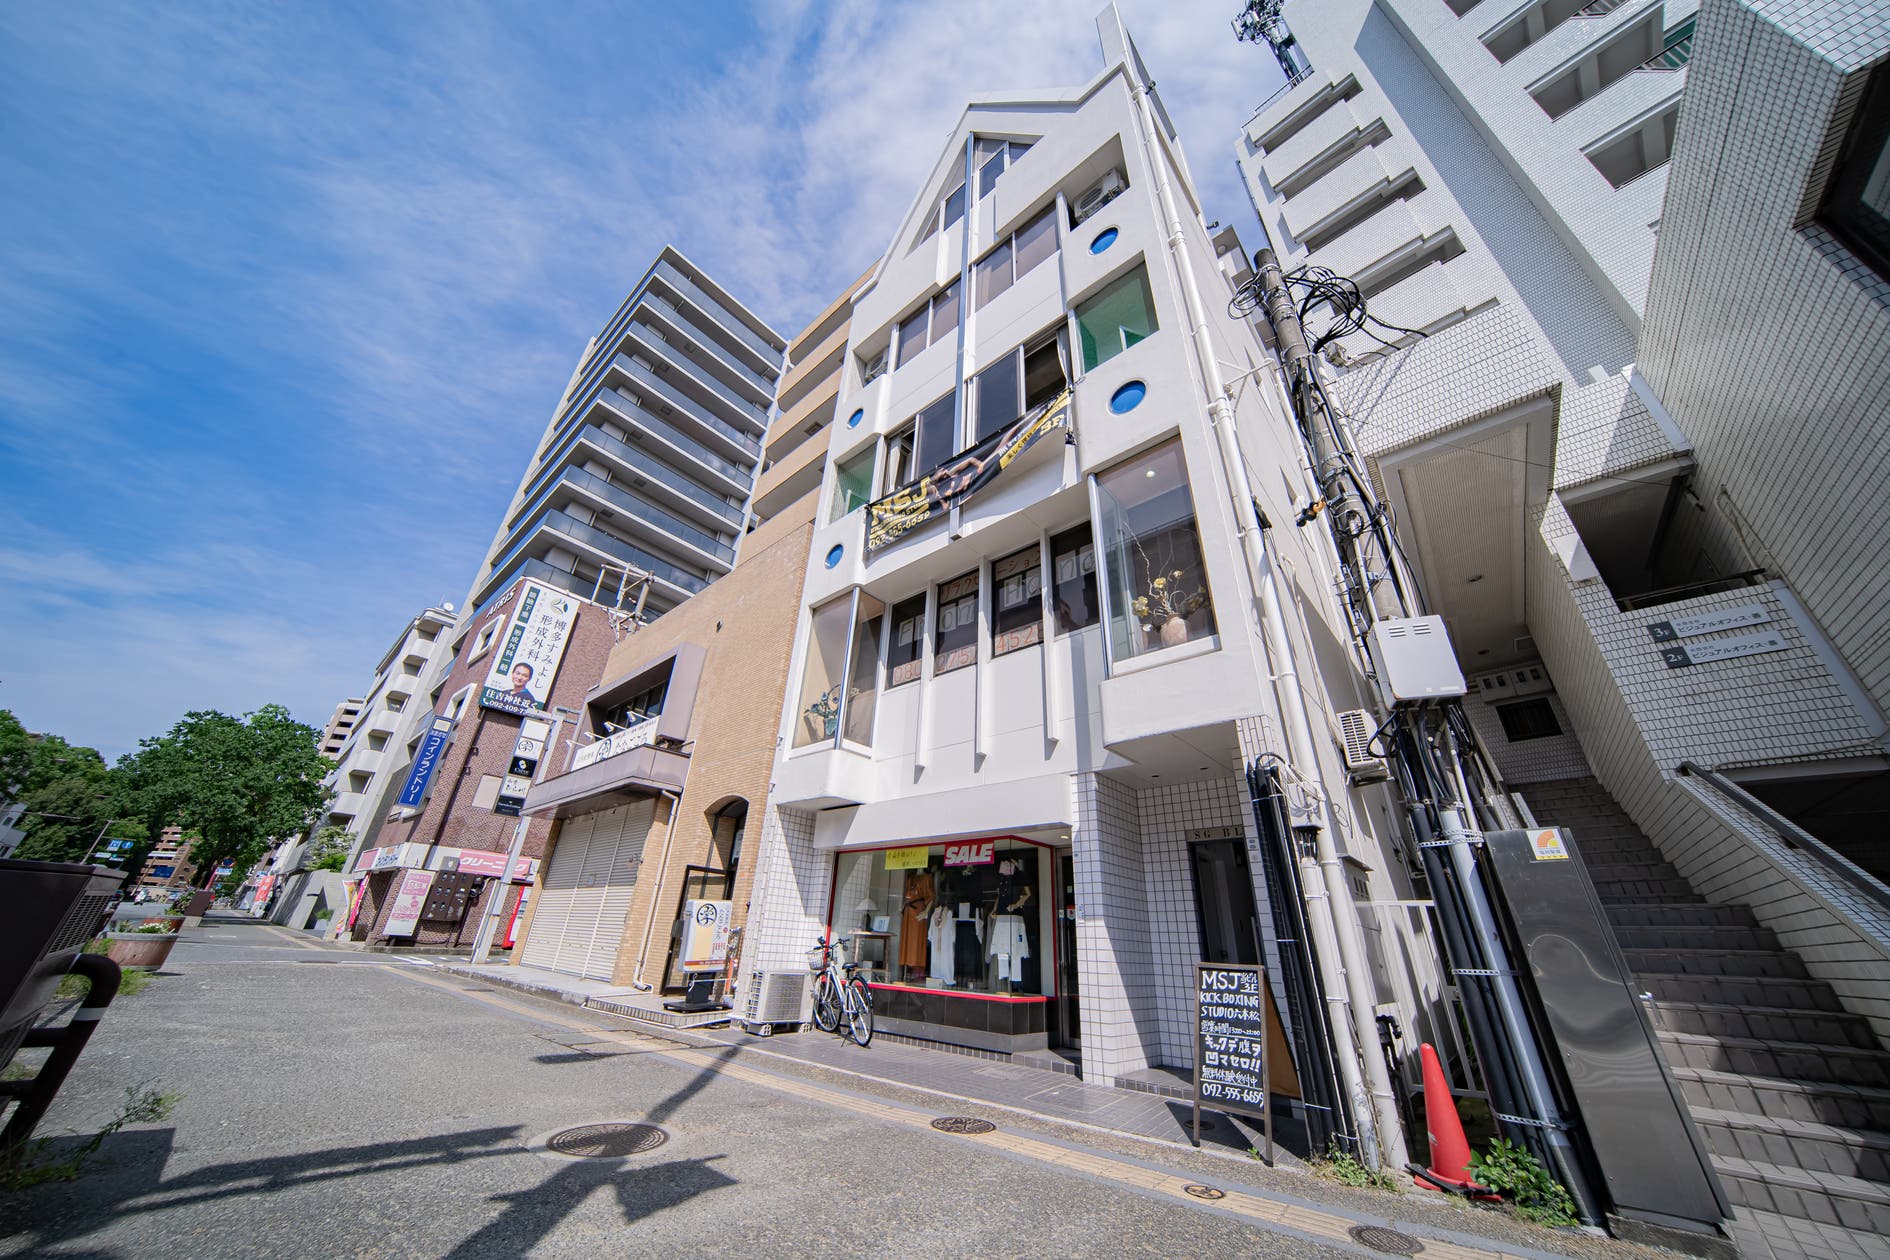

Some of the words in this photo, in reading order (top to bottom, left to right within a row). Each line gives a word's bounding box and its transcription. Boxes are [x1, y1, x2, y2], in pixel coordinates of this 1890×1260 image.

[871, 476, 931, 528] MSJ
[527, 614, 553, 662] 形成外科
[534, 620, 567, 688] 博多すみよし
[408, 737, 442, 802] コインランドリー
[1194, 829, 1211, 840] SG
[460, 856, 528, 872] クリーニグ
[945, 843, 994, 864] SALE
[1201, 971, 1240, 990] MSJ
[1200, 991, 1221, 1004] KICK
[1223, 993, 1259, 1008] BOXING
[1202, 1083, 1264, 1108] 092-555-6659
